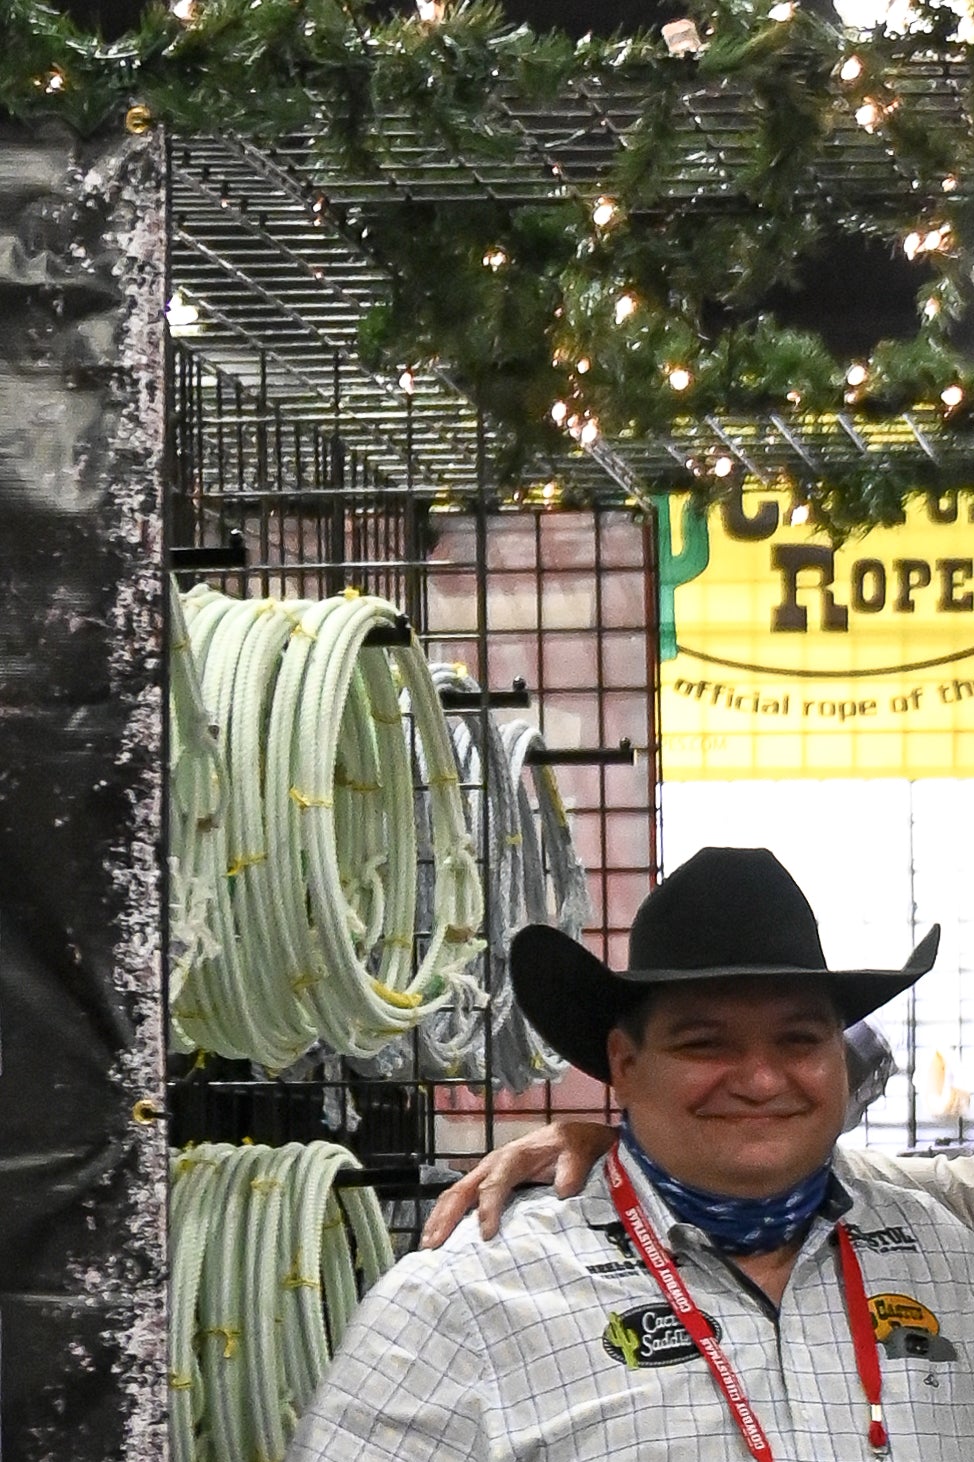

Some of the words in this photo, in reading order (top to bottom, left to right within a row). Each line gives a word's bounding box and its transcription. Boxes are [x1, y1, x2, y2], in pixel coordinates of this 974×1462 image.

[673, 678, 791, 716] official
[802, 697, 878, 723] rope
[890, 687, 923, 714] of
[625, 1207, 666, 1268] CHRISTMAS
[659, 1268, 692, 1313] COWBOY
[736, 1402, 765, 1450] COWBOY
